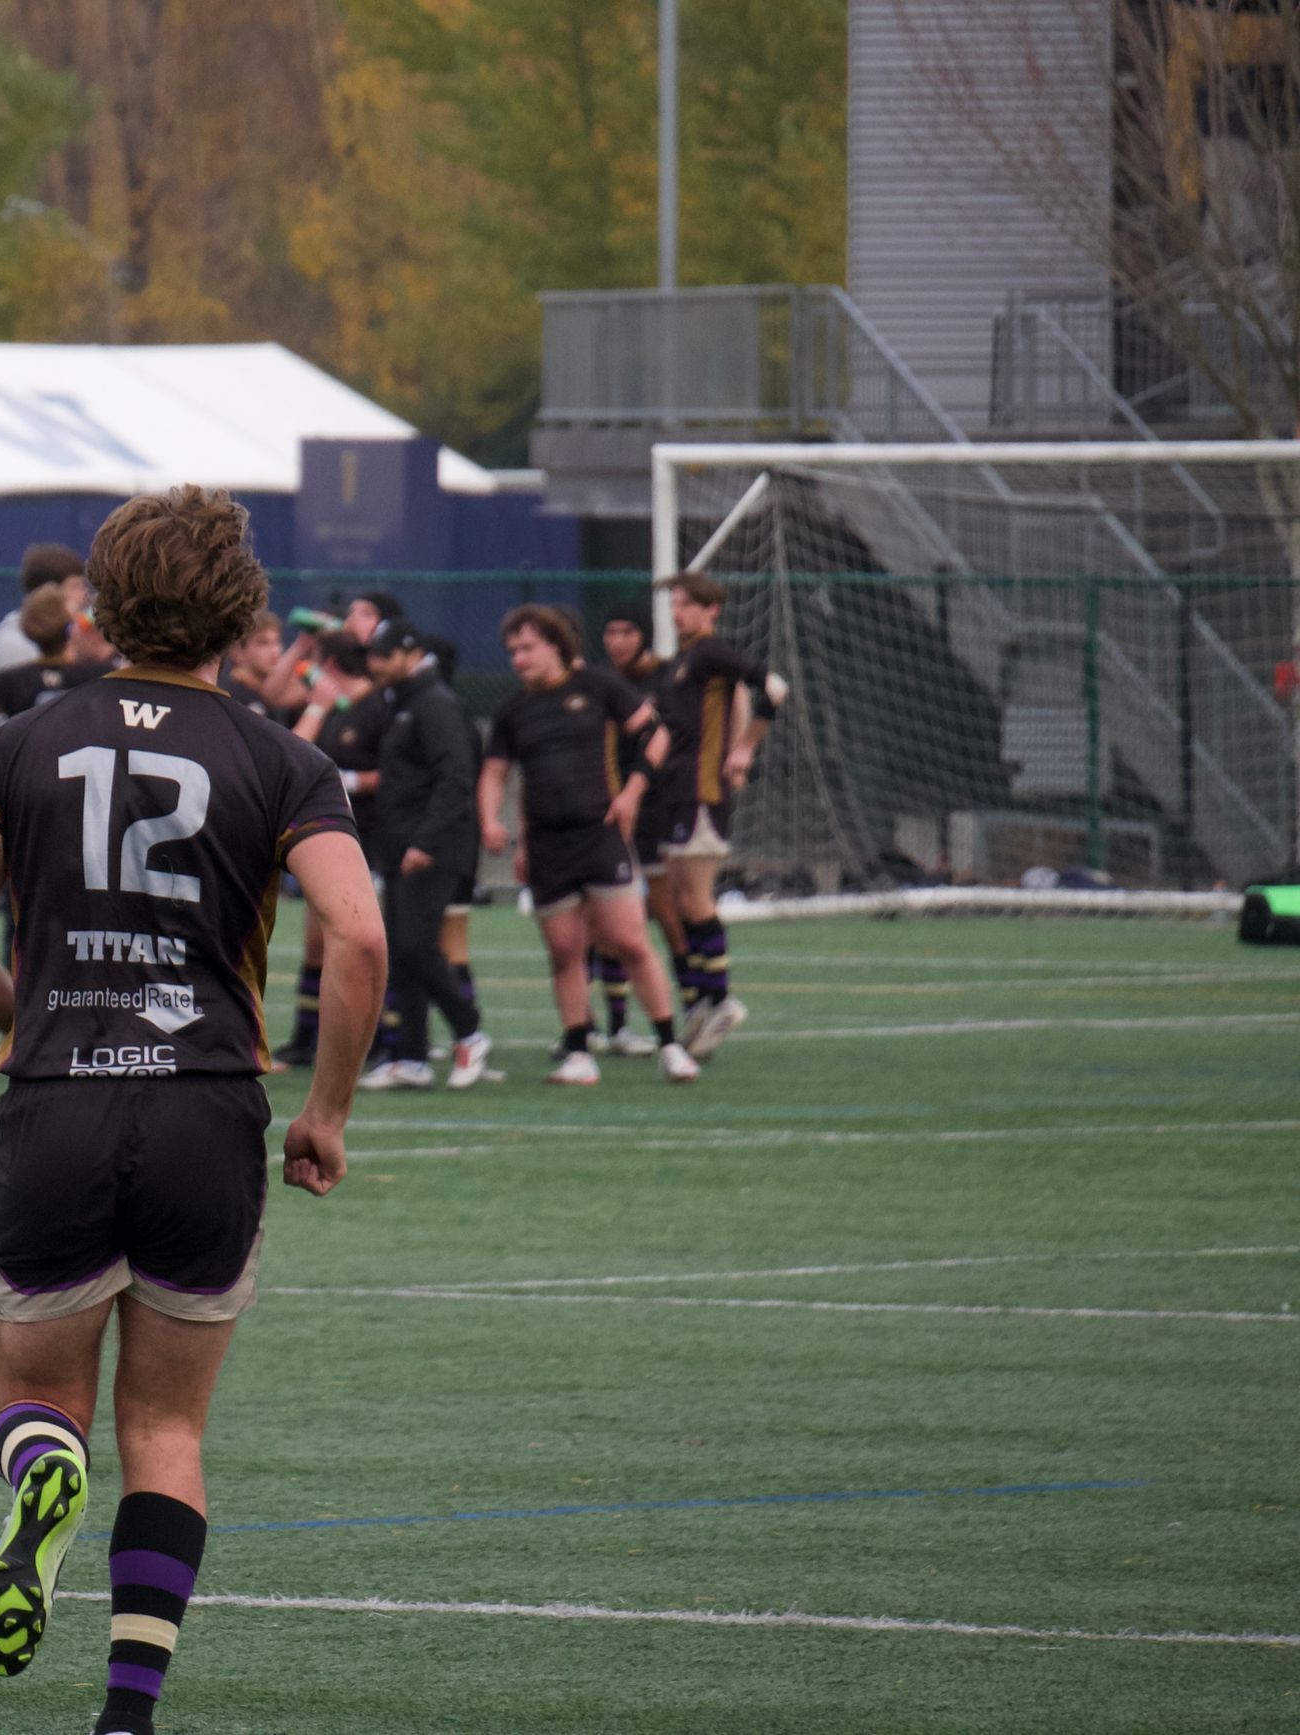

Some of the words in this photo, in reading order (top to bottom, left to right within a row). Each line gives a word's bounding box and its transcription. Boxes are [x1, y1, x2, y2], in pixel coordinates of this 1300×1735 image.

[119, 699, 171, 729] W
[58, 745, 211, 903] 12
[67, 930, 186, 965] TITAN
[47, 987, 143, 1011] guaranteed
[149, 987, 191, 1008] Rate
[71, 1045, 176, 1067] LOGIC
